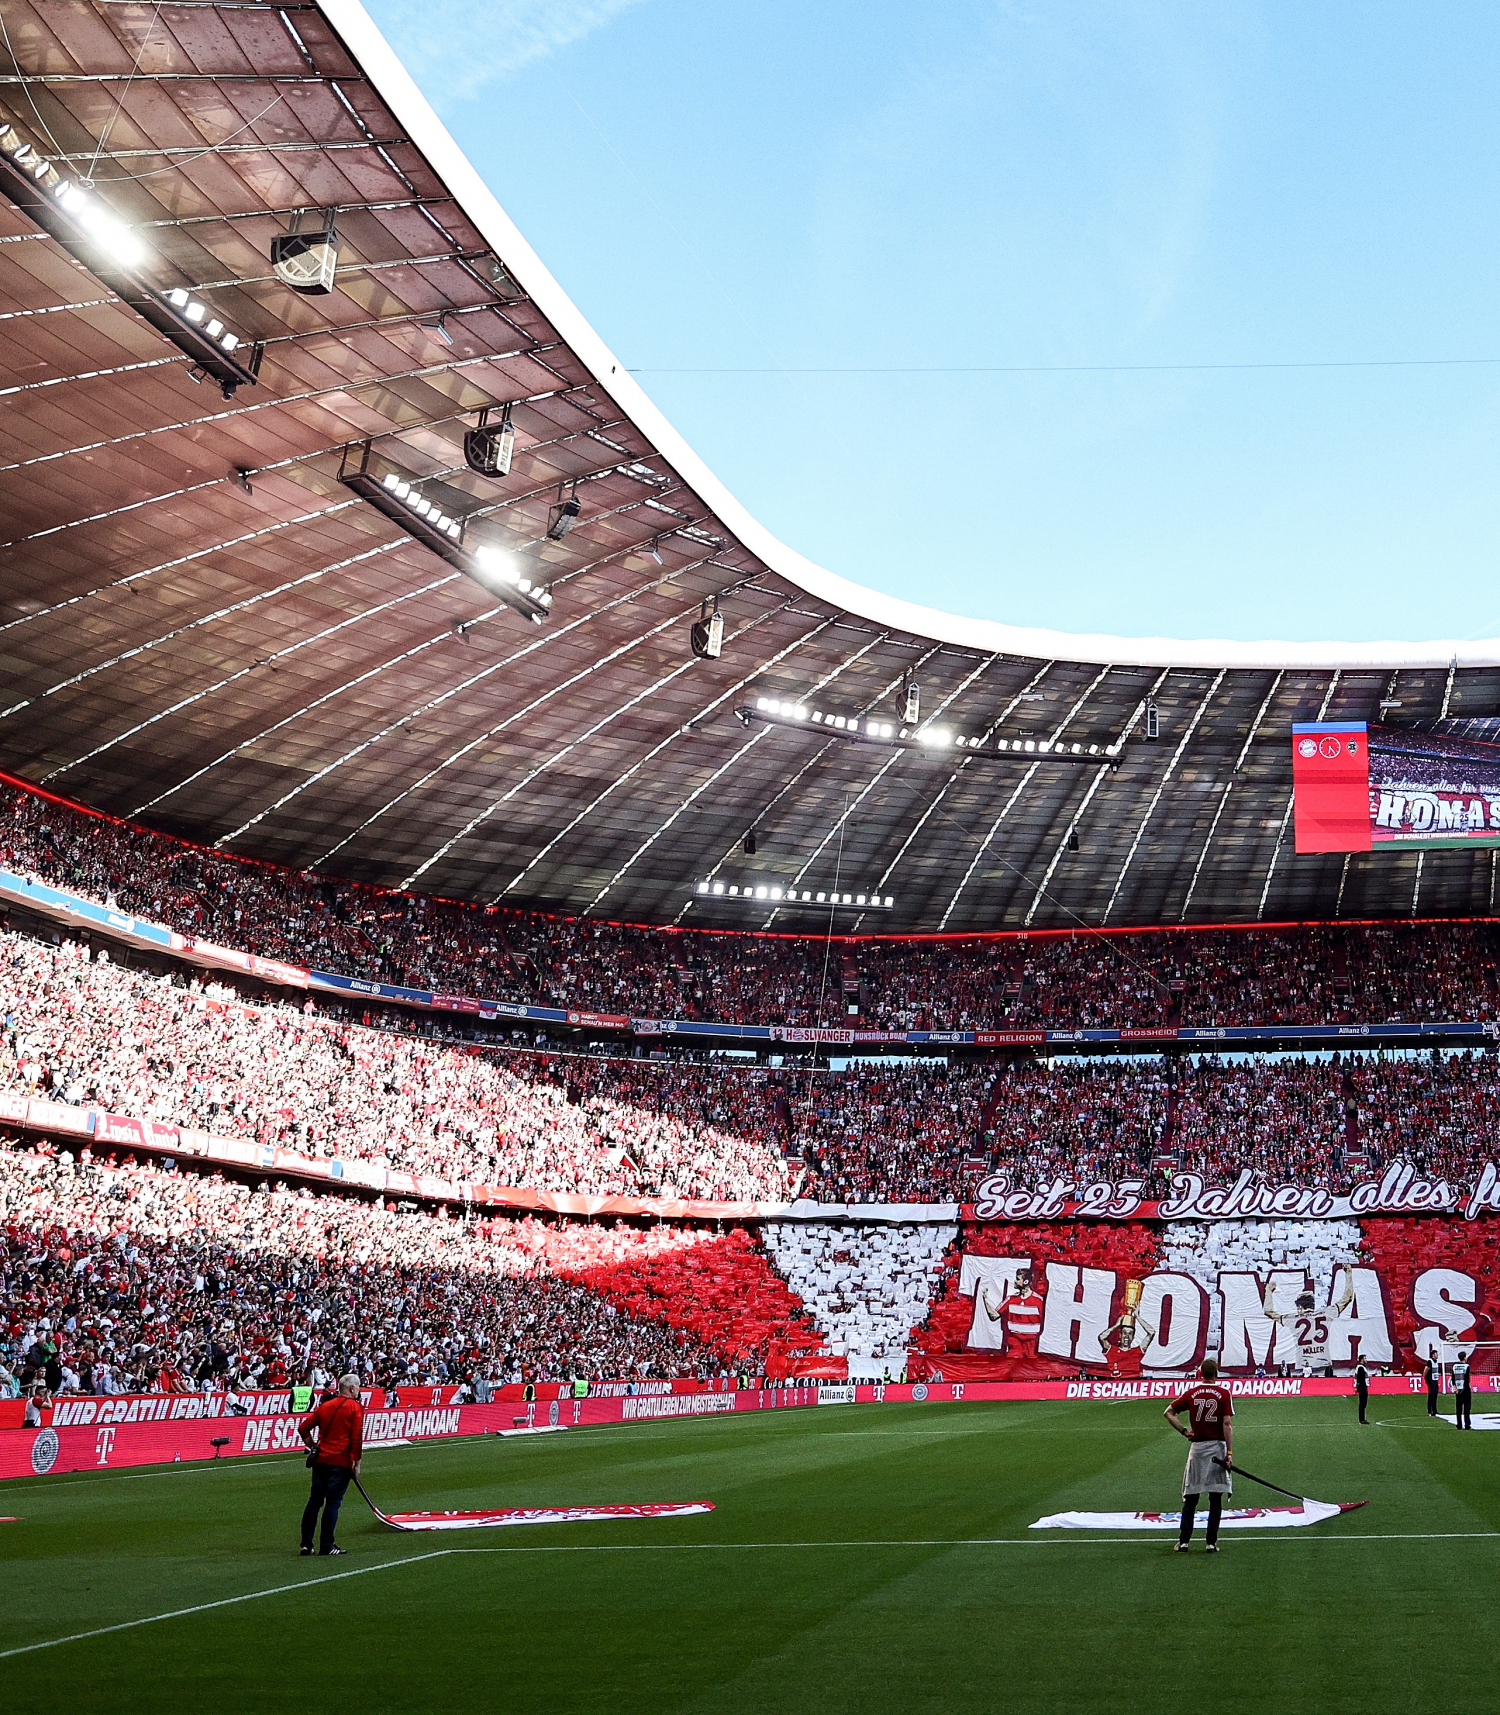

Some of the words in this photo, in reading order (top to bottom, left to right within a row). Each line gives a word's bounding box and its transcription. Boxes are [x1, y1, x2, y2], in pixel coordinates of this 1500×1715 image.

[349, 981, 371, 991] Allianz
[496, 1004, 518, 1014] Allianz
[929, 1033, 951, 1041] Allianz
[977, 1034, 996, 1043] RED
[999, 1033, 1043, 1042] RELIGION
[1051, 1031, 1073, 1039] Allianz
[1120, 1028, 1178, 1038] GROSSHEIDE
[1338, 1026, 1360, 1035] Allianz
[974, 1175, 1077, 1220] Seit
[1075, 1178, 1145, 1218] 25
[1157, 1168, 1335, 1220] Jahren
[1350, 1159, 1460, 1212] alles
[960, 1253, 1478, 1369] THOMAS
[1294, 1316, 1329, 1346] 25
[1302, 1346, 1325, 1356] MÜLLER
[819, 1389, 845, 1401] Allianz
[1066, 1383, 1092, 1398] DIE
[1093, 1382, 1148, 1398] SCHALE
[1150, 1381, 1174, 1397] IST
[1232, 1380, 1302, 1396] DAHOAM!
[51, 1401, 97, 1426] WIR
[622, 1398, 637, 1419] WIR
[637, 1396, 681, 1418] GRATULIEREN
[680, 1395, 693, 1414] ZUR
[1193, 1398, 1218, 1422] 72
[405, 1408, 461, 1437] DAHOAM!
[242, 1419, 274, 1452] DIE
